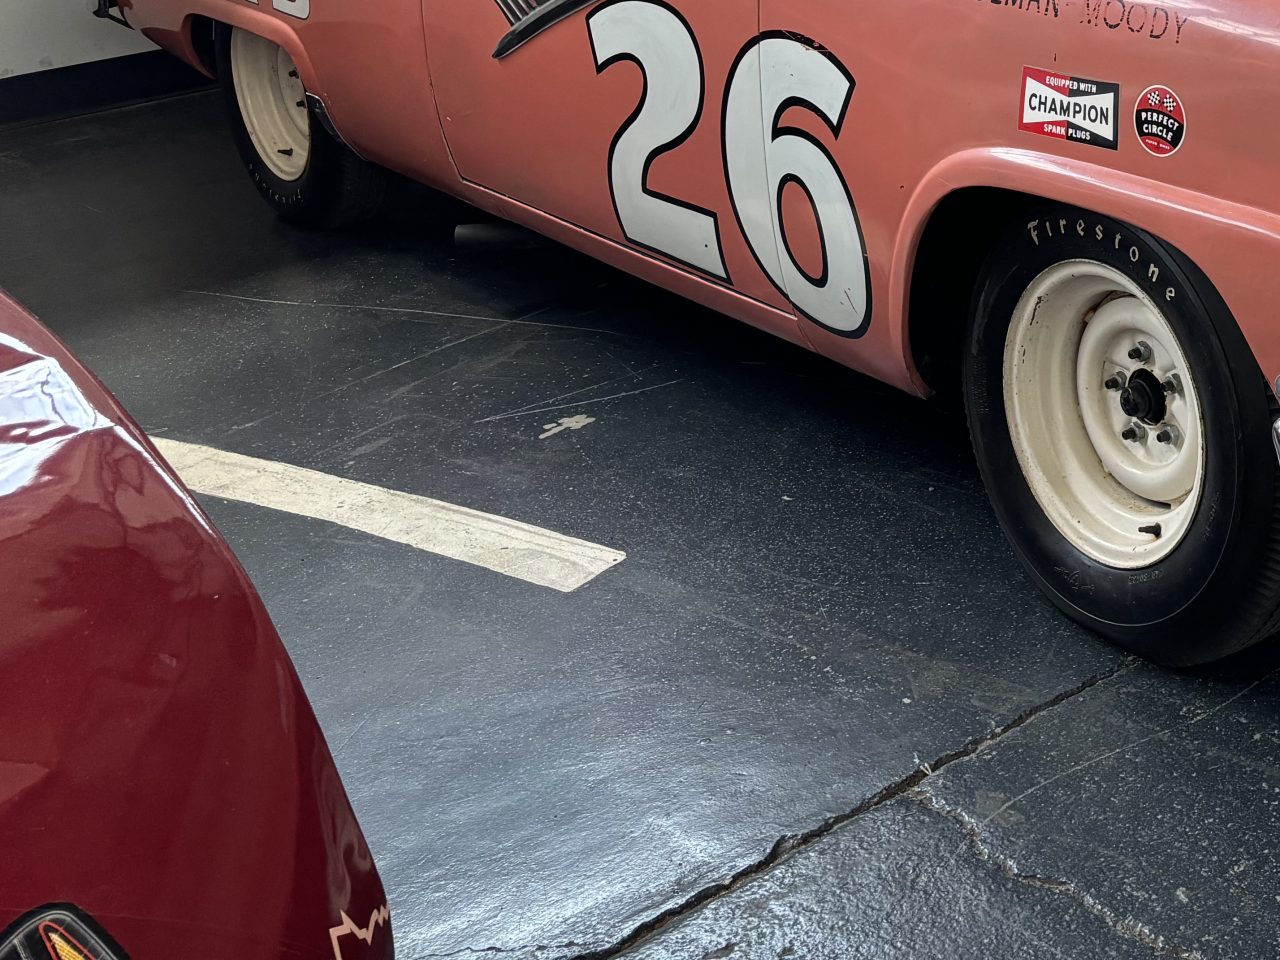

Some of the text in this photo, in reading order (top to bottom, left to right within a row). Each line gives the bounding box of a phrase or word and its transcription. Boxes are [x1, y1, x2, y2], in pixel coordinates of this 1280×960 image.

[1045, 75, 1097, 94] EQUIPPED WITH
[1028, 92, 1109, 125] CHAMPION
[1141, 112, 1179, 130] PERFECT
[1043, 123, 1091, 141] SPARK PLUGS
[1143, 124, 1173, 141] CIRCLE
[1027, 219, 1175, 301] Firestone
